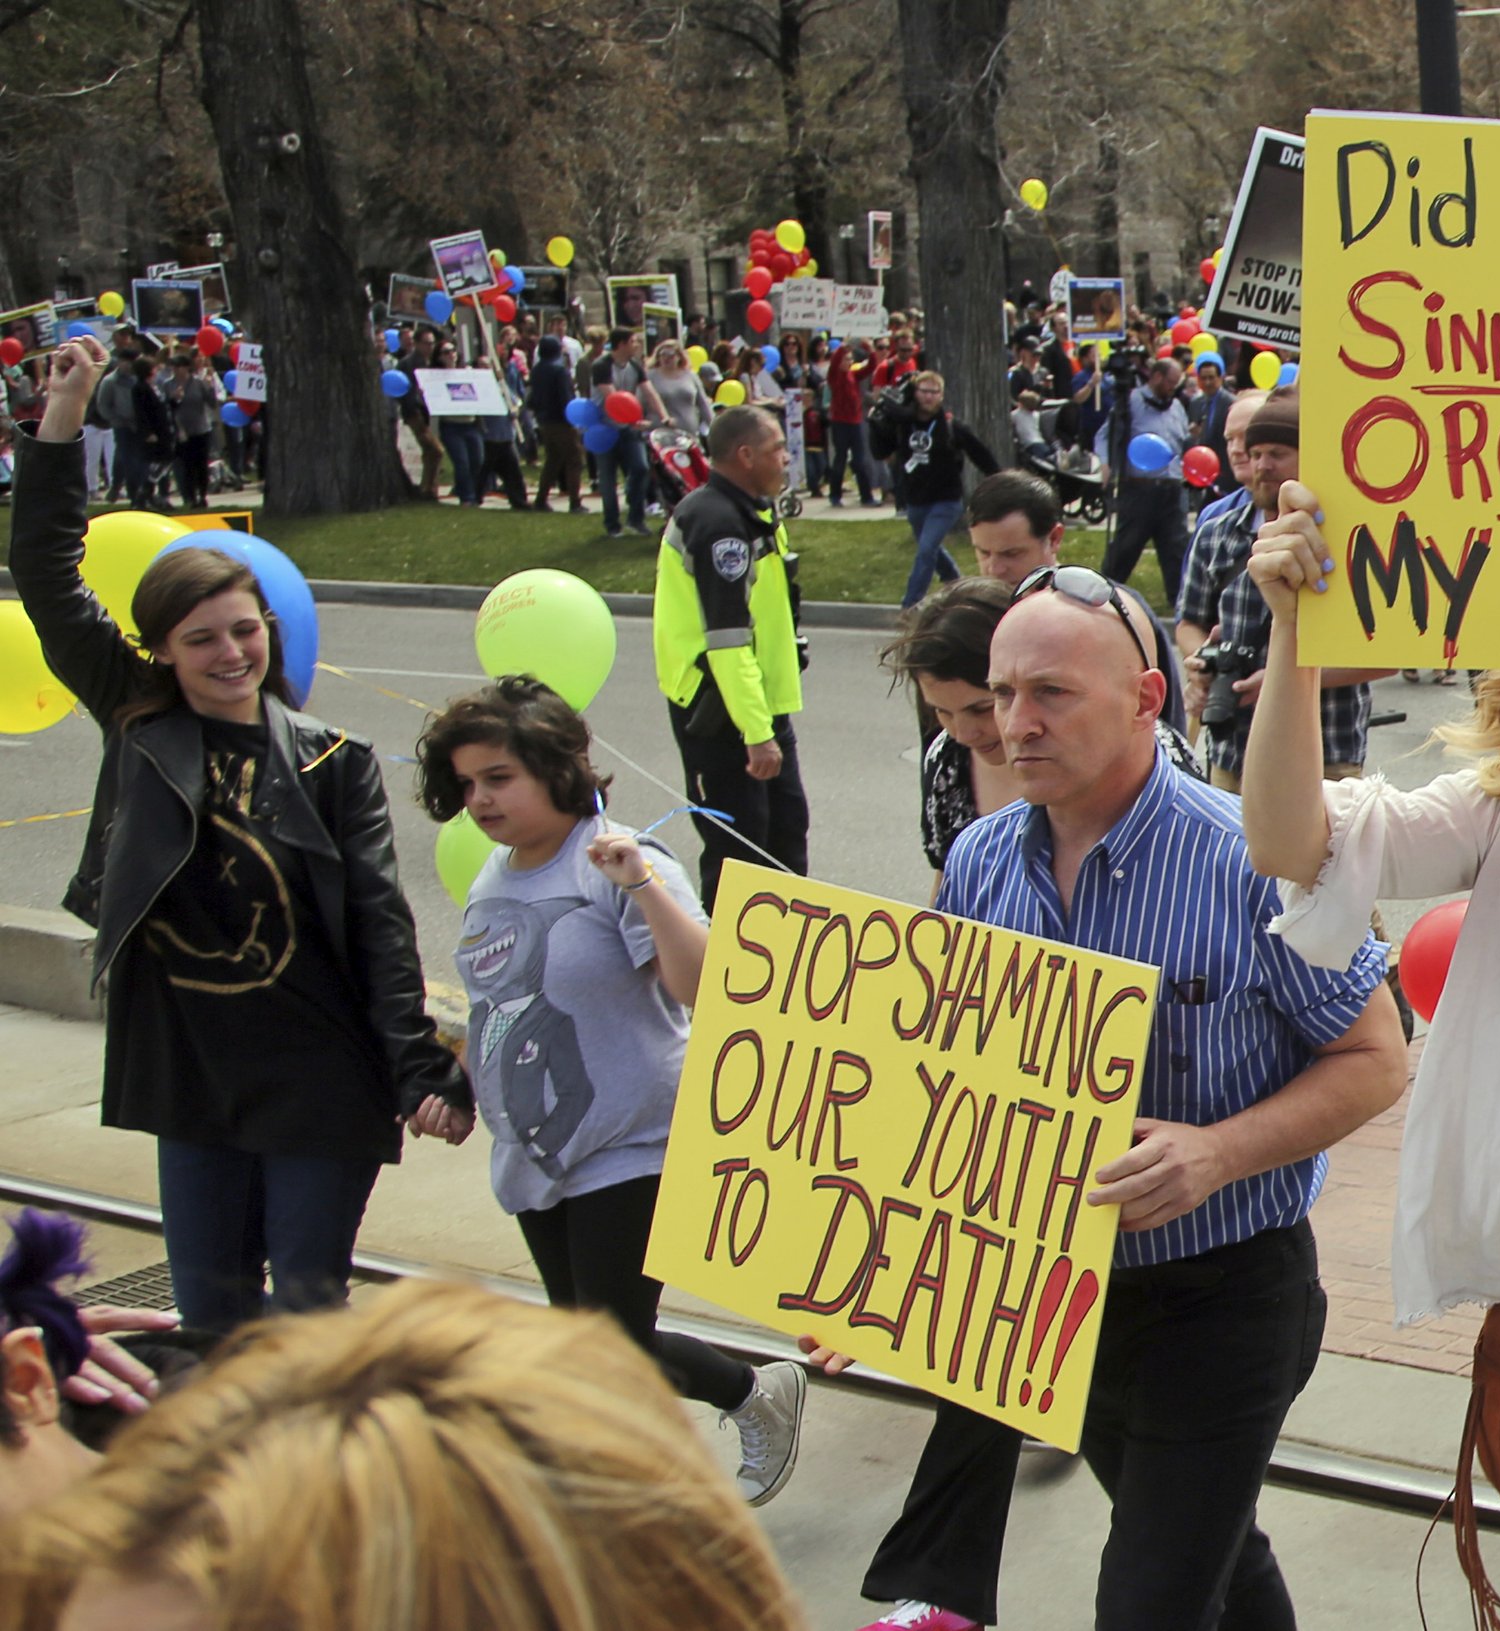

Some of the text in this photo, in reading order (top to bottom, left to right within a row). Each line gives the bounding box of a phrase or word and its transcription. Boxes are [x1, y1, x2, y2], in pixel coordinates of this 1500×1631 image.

[1336, 137, 1477, 250] Did
[1240, 256, 1287, 283] STOP
[1346, 511, 1493, 668] MY
[724, 891, 1148, 1105] STOP SHAMING
[711, 1029, 1103, 1253] OUR YOUTH
[704, 1157, 770, 1268] TO
